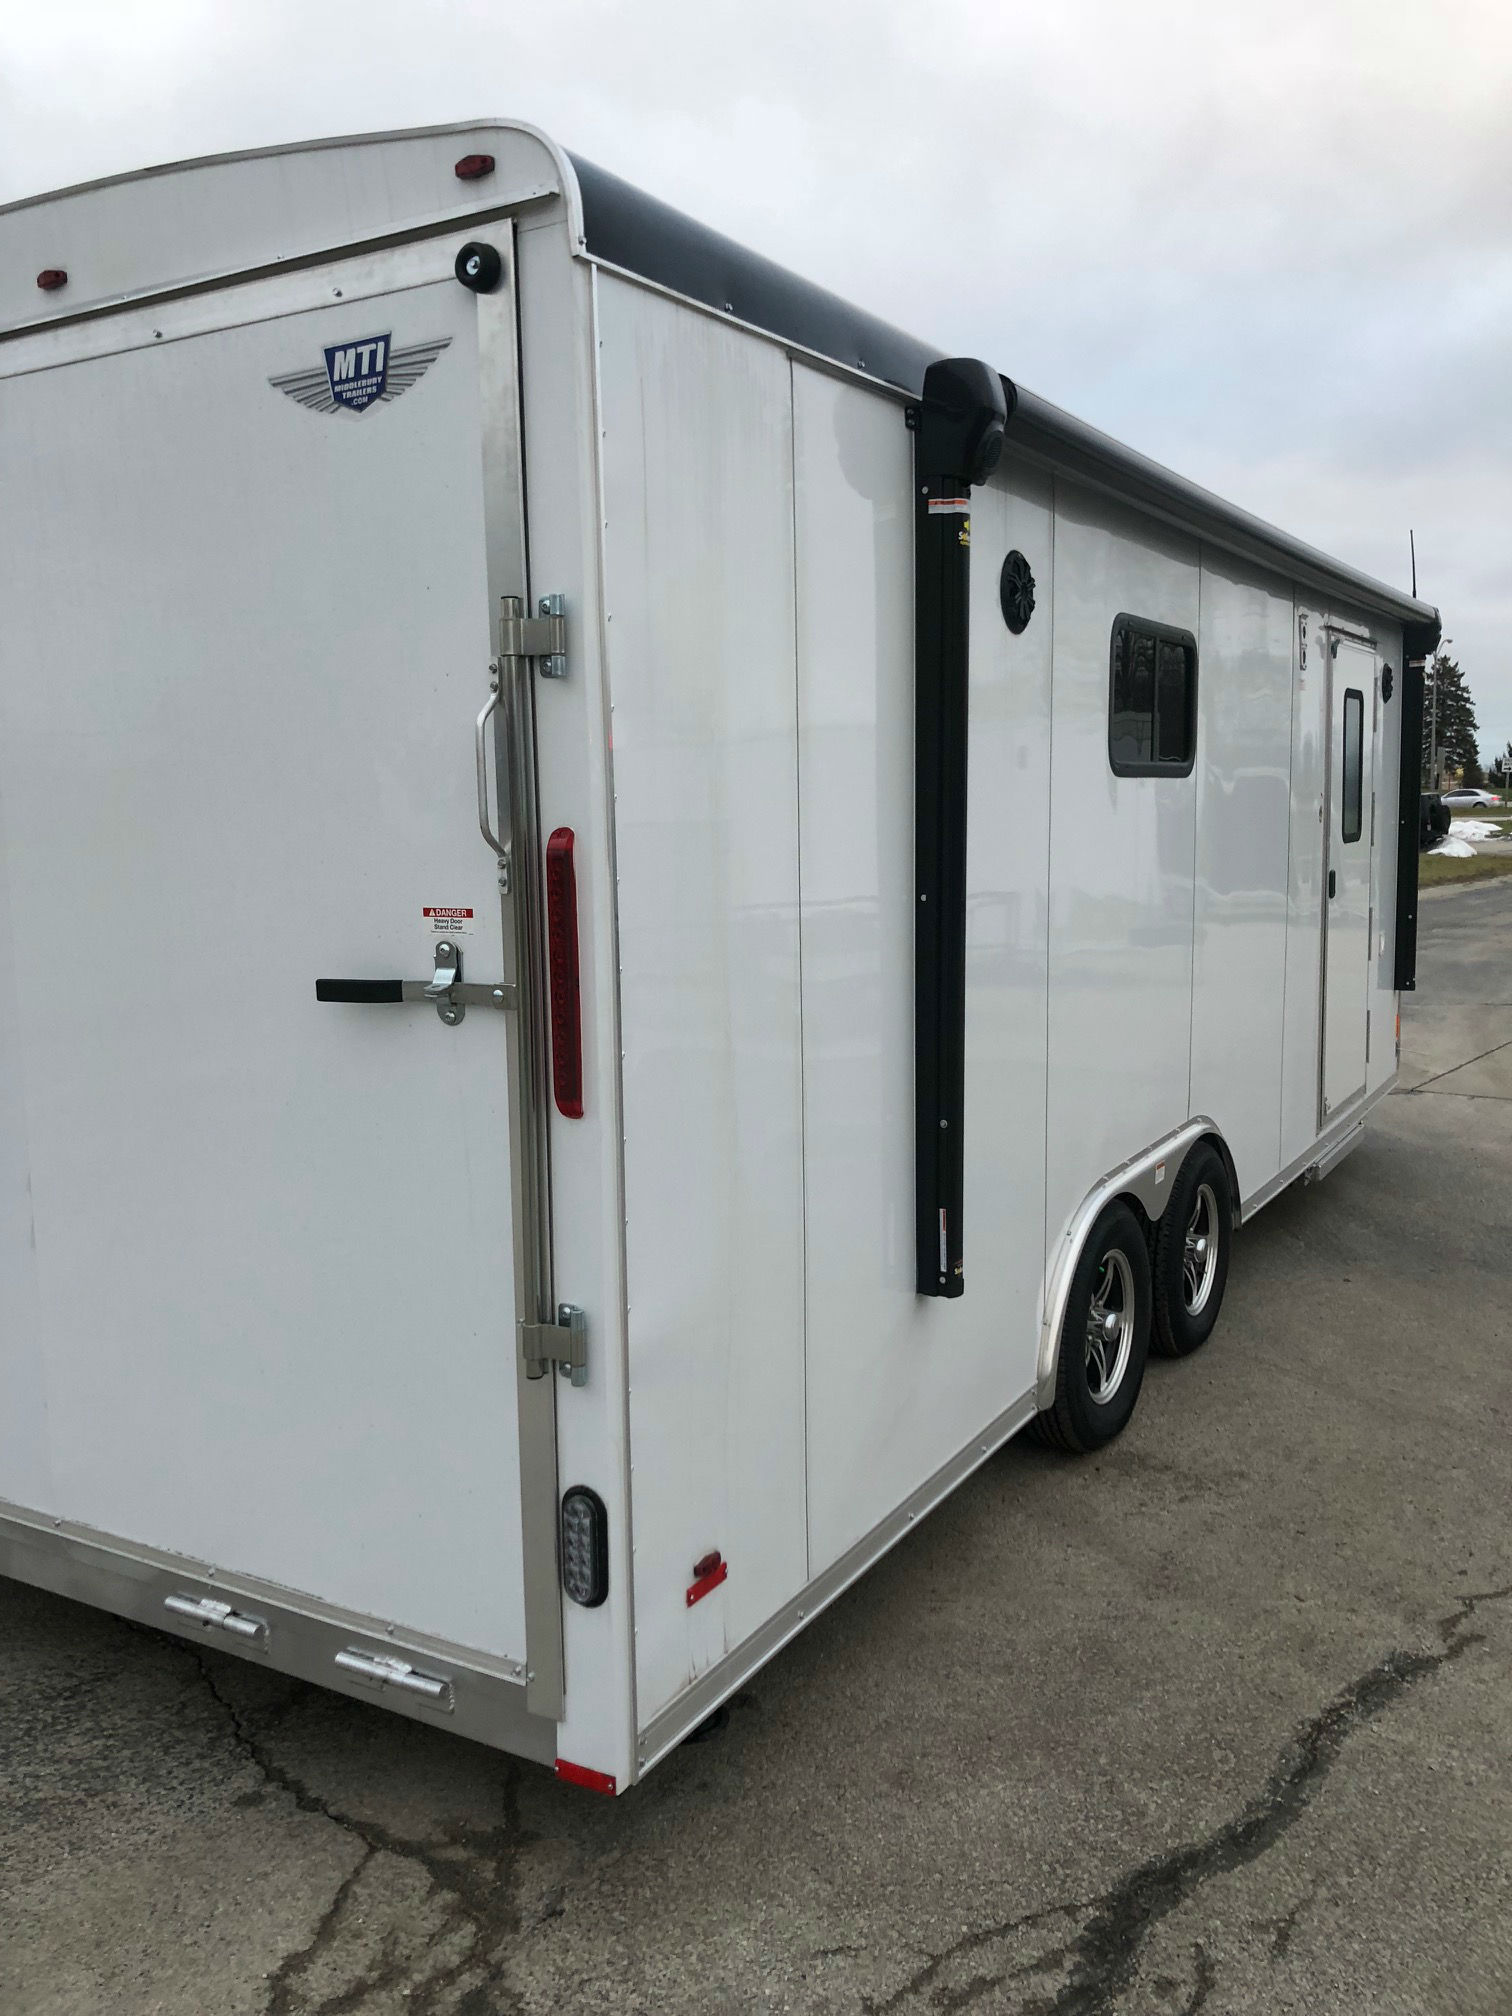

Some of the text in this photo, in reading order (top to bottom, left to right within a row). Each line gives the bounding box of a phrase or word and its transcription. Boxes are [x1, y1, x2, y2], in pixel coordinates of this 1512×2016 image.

[333, 341, 385, 382] MTI
[334, 376, 383, 393] MIDDLEBURY
[342, 385, 377, 399] TRAILERS
[435, 909, 467, 917] DANGER
